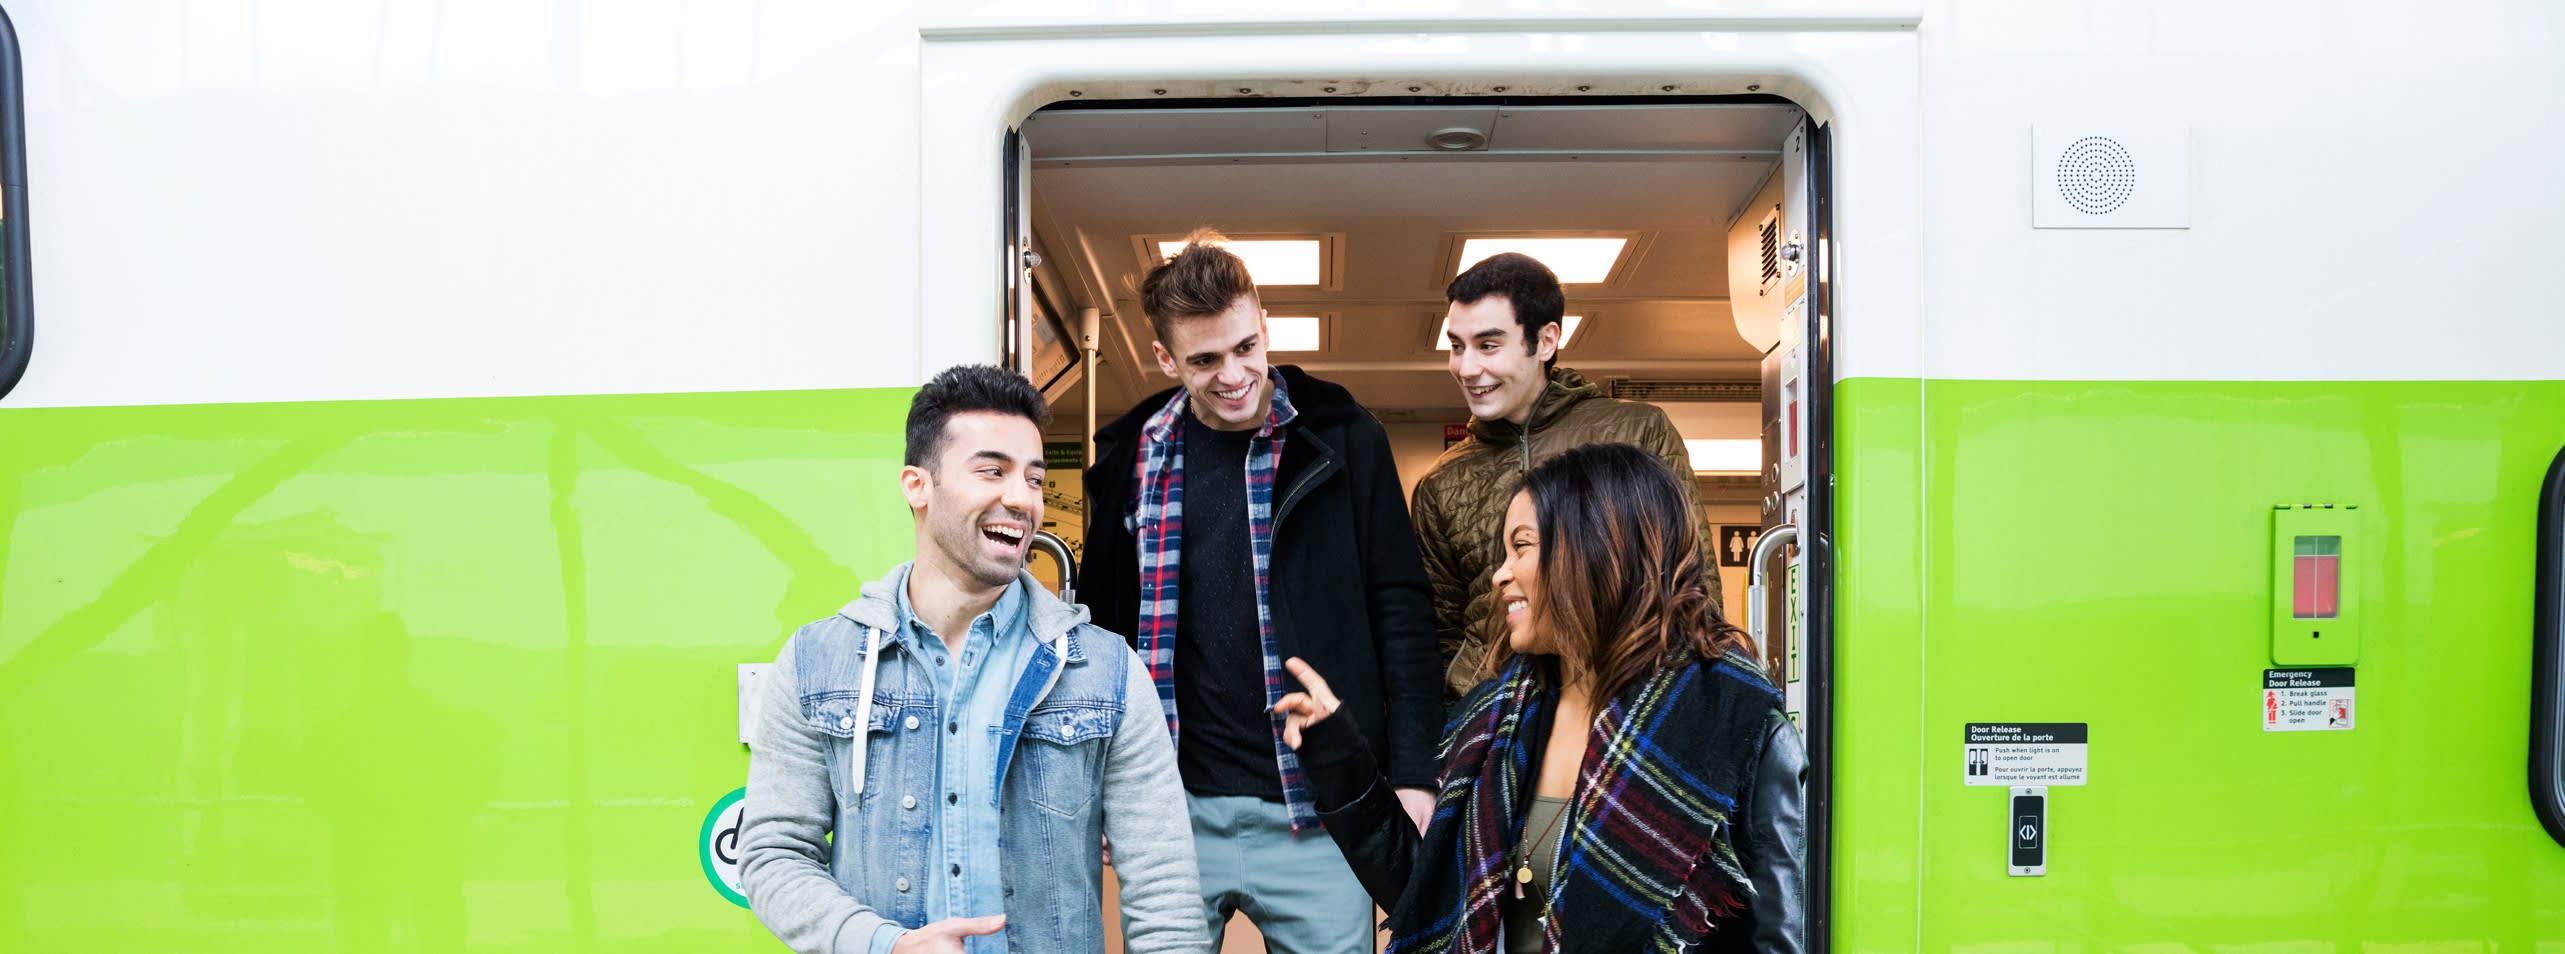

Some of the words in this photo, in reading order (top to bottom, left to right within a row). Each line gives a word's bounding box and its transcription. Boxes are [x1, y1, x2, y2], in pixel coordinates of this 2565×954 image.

[2269, 671, 2312, 679] Emergency
[2269, 679, 2288, 687] Door
[2289, 679, 2321, 687] Release
[2032, 734, 2054, 743] porte
